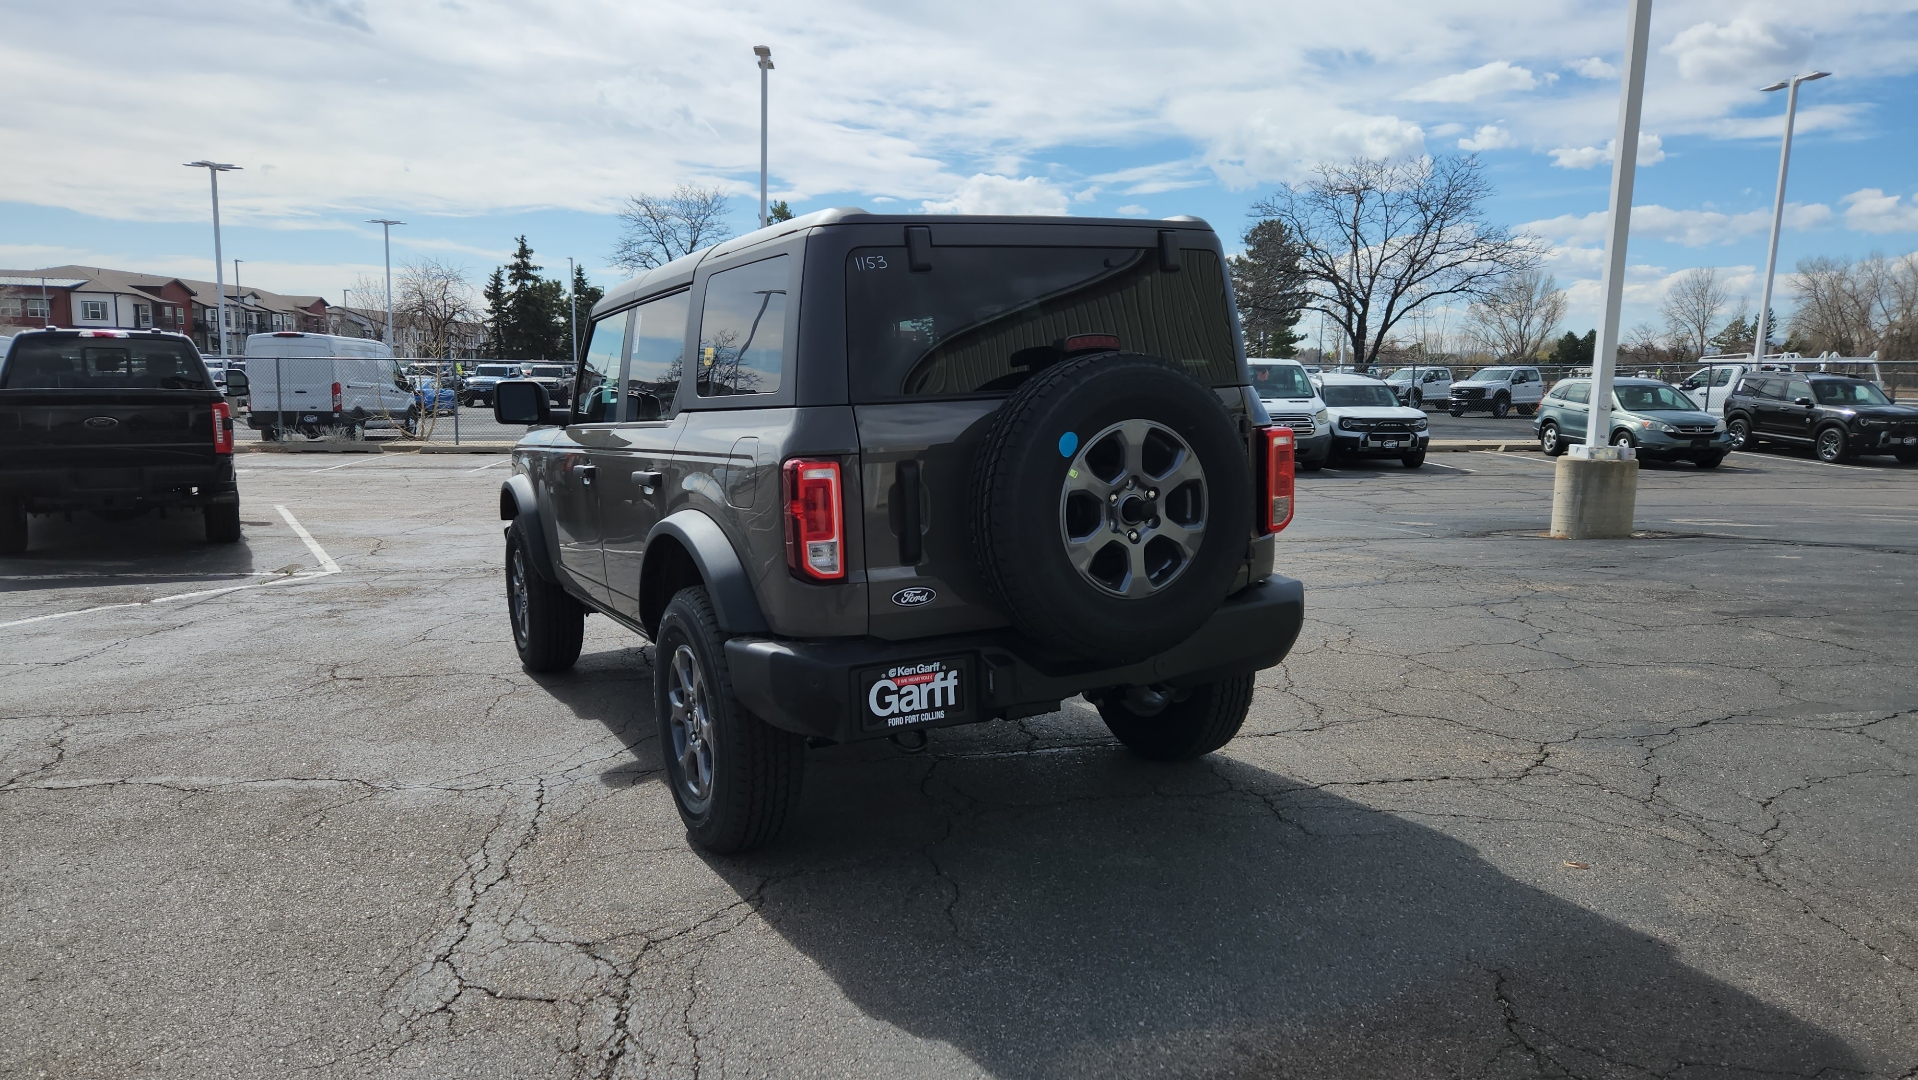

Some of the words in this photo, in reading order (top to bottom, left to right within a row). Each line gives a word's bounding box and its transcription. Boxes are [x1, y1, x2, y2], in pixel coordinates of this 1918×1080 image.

[855, 255, 888, 272] 1153
[900, 590, 929, 603] Ford
[897, 666, 916, 676] Ken
[917, 662, 940, 673] Garff
[869, 670, 958, 717] Garff
[888, 717, 904, 727] FORD
[904, 714, 919, 724] FORT
[920, 711, 945, 721] COLLINS
